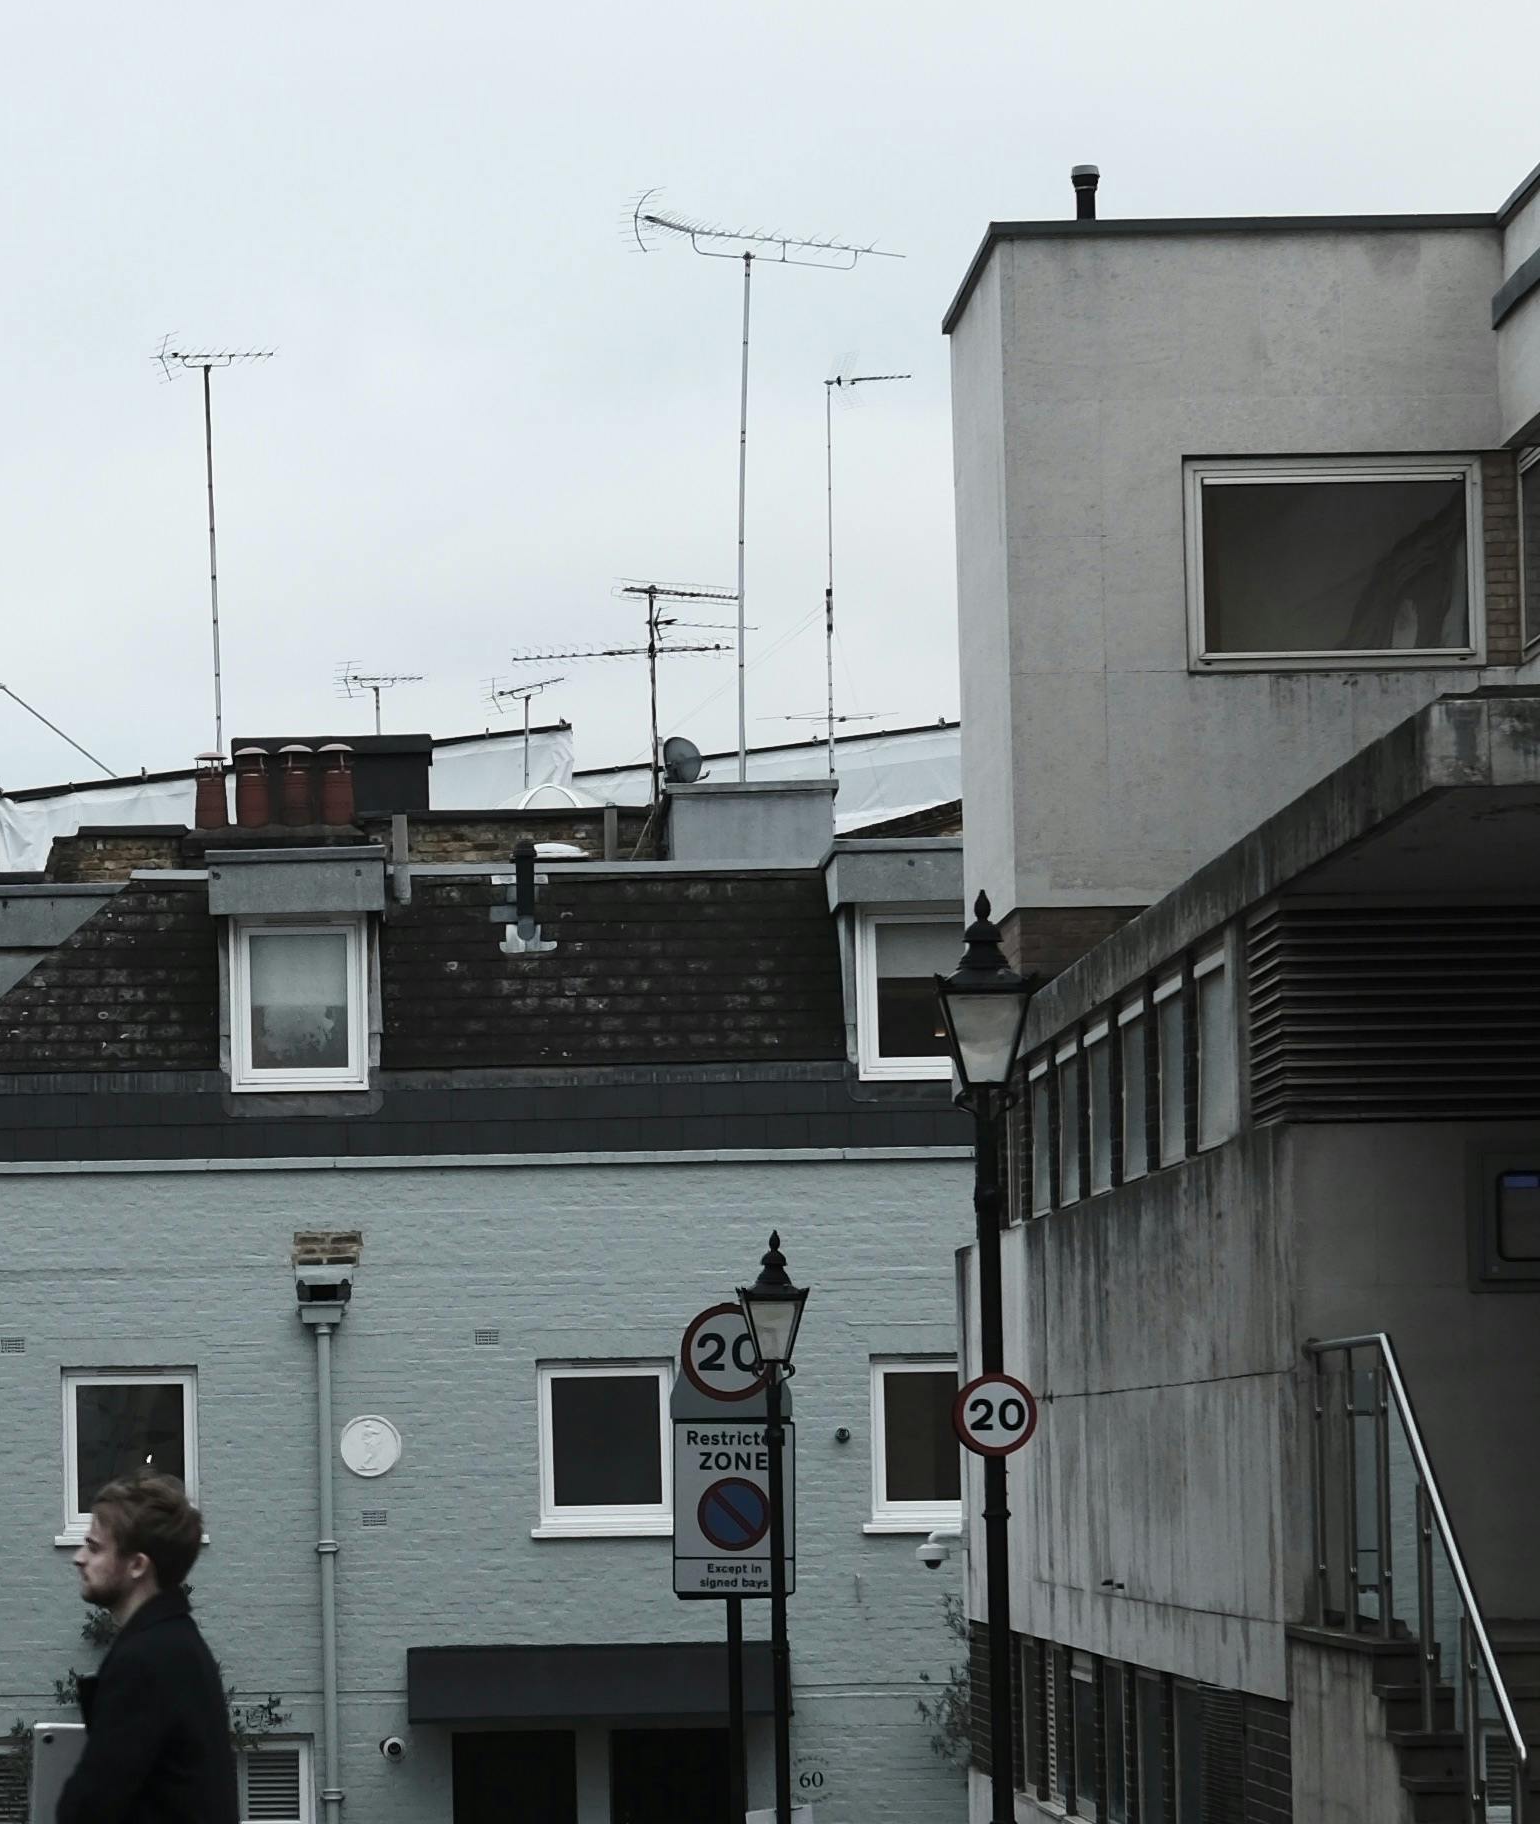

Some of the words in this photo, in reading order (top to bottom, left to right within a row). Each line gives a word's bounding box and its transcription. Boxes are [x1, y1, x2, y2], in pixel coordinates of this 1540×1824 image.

[697, 1332, 758, 1372] 20
[969, 1398, 1026, 1431] 20
[699, 1451, 769, 1471] ZONE
[707, 1563, 747, 1574] Except
[751, 1563, 762, 1573] in
[700, 1578, 738, 1589] signed
[742, 1578, 769, 1589] bays
[799, 1771, 824, 1788] 60
